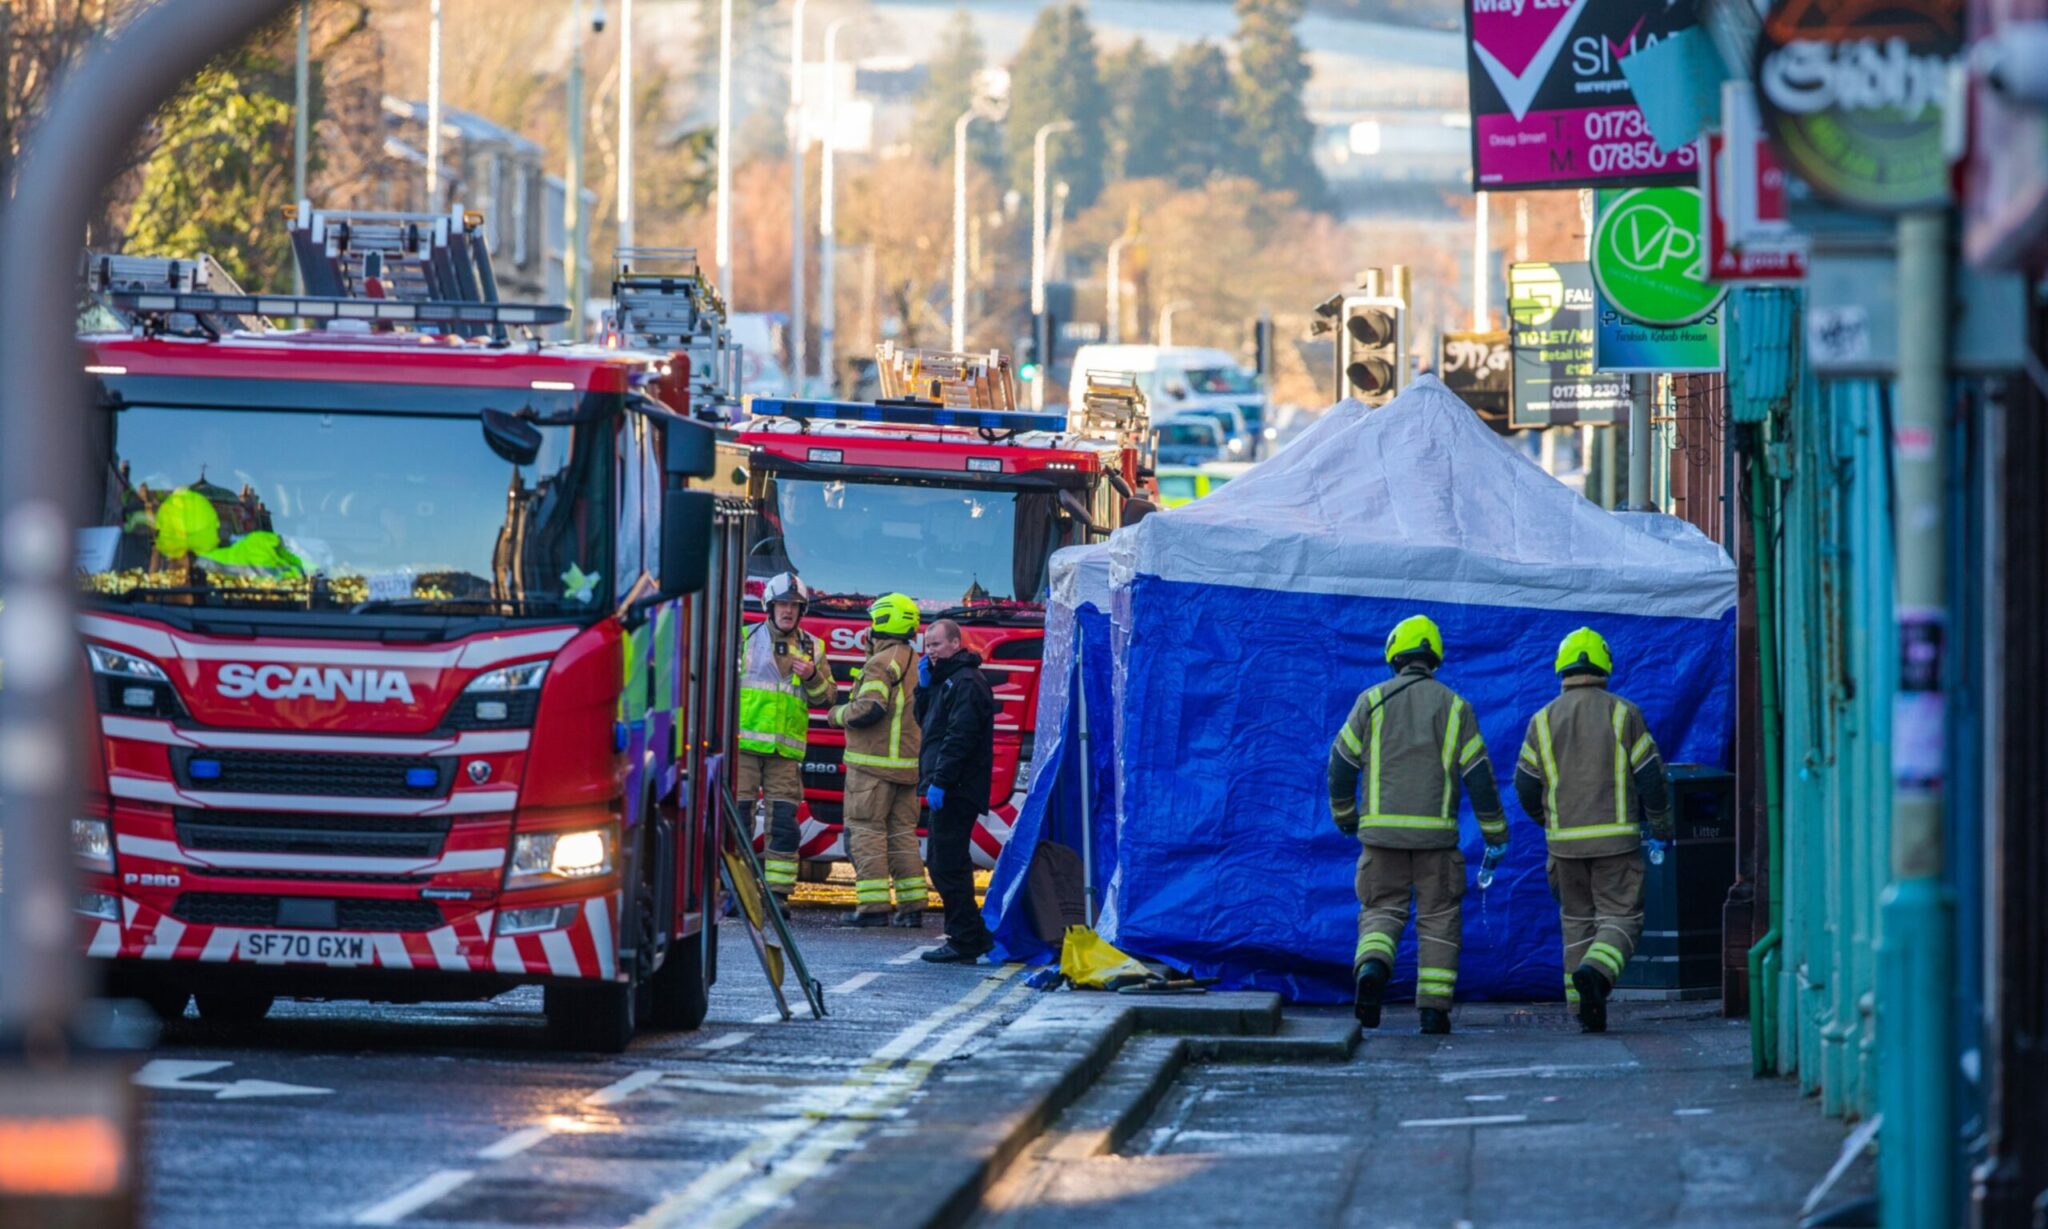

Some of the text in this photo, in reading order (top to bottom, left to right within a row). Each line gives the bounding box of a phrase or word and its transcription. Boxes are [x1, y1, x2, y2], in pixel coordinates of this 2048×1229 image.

[1473, 0, 1524, 17] May
[1588, 141, 1667, 172] 07850
[1519, 331, 1540, 346] TO
[1615, 330, 1708, 343] Turkish Kebab House
[216, 663, 416, 704] SCANIA
[804, 761, 837, 773] 280
[1692, 826, 1720, 839] Litter
[124, 872, 181, 888] P 280
[249, 933, 364, 959] SF70 GXW
